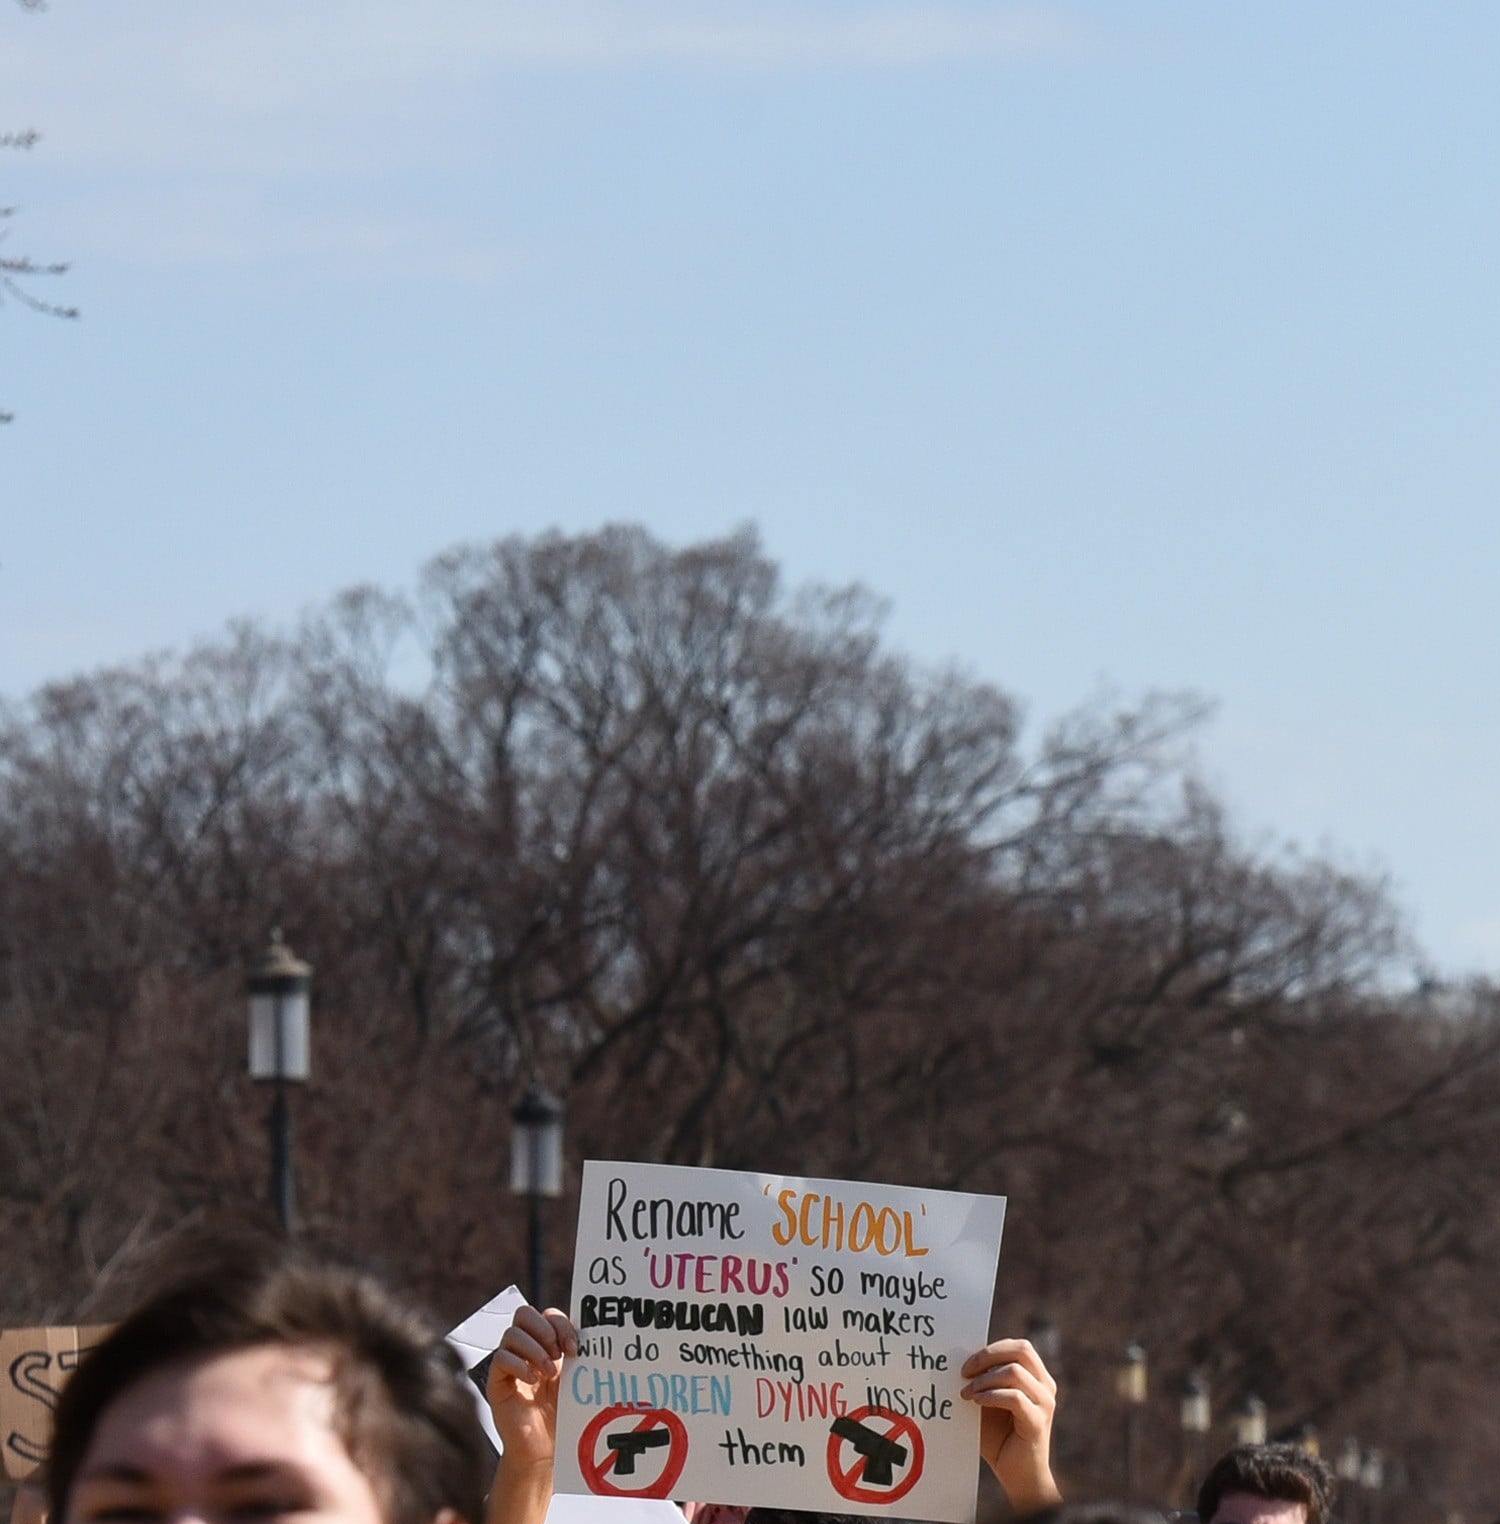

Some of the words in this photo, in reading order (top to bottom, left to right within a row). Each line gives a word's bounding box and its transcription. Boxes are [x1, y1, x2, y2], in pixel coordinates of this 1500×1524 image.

[606, 1178, 745, 1242] Rename
[764, 1183, 930, 1257] 'SCHOOL'
[589, 1256, 627, 1285] as
[644, 1247, 799, 1298] 'UTERUS'
[810, 1265, 844, 1297] so
[860, 1271, 948, 1305] maybe
[580, 1295, 763, 1336] REPUBLICAN
[784, 1306, 828, 1333] law
[843, 1307, 935, 1337] makers
[577, 1335, 612, 1360] will
[624, 1334, 660, 1361] do
[679, 1341, 805, 1384] something
[818, 1336, 891, 1367] about
[907, 1345, 948, 1371] the
[572, 1365, 732, 1416] CHILDREN
[756, 1377, 848, 1423] DYING
[865, 1376, 953, 1420] inside
[718, 1428, 805, 1467] them
